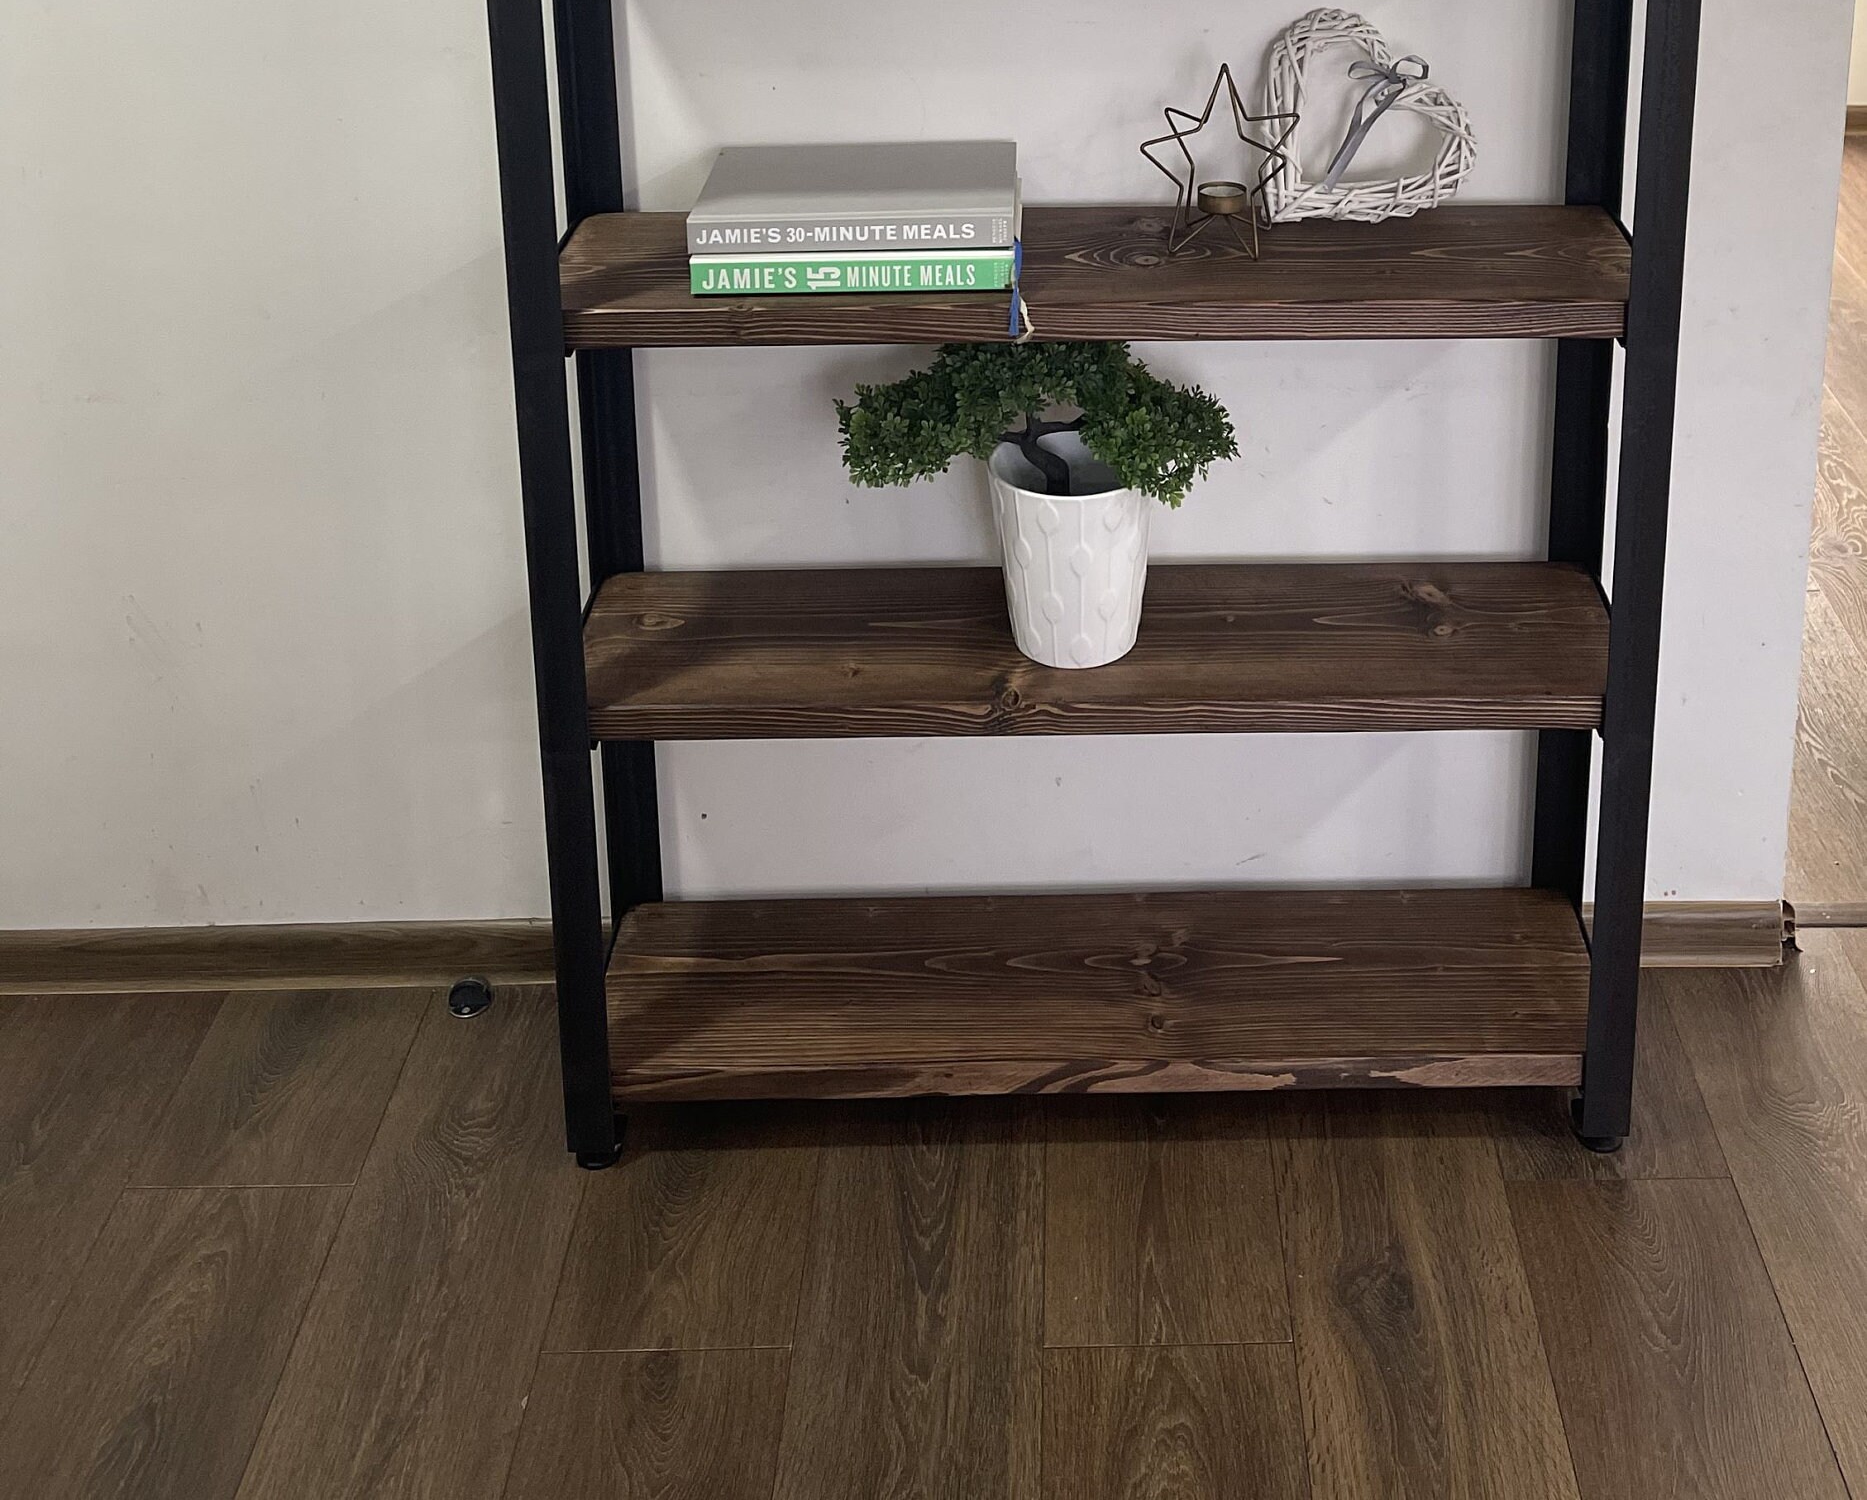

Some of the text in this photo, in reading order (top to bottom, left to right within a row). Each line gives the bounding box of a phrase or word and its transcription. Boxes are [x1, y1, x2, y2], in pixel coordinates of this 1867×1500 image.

[696, 227, 782, 245] JAMIE'S
[786, 225, 897, 243] 30-MINUTE
[903, 223, 976, 240] MEALS
[702, 267, 797, 290] JAMIE'S
[806, 266, 841, 290] 15
[846, 265, 912, 288] MINUTE
[920, 264, 976, 286] MEALS
